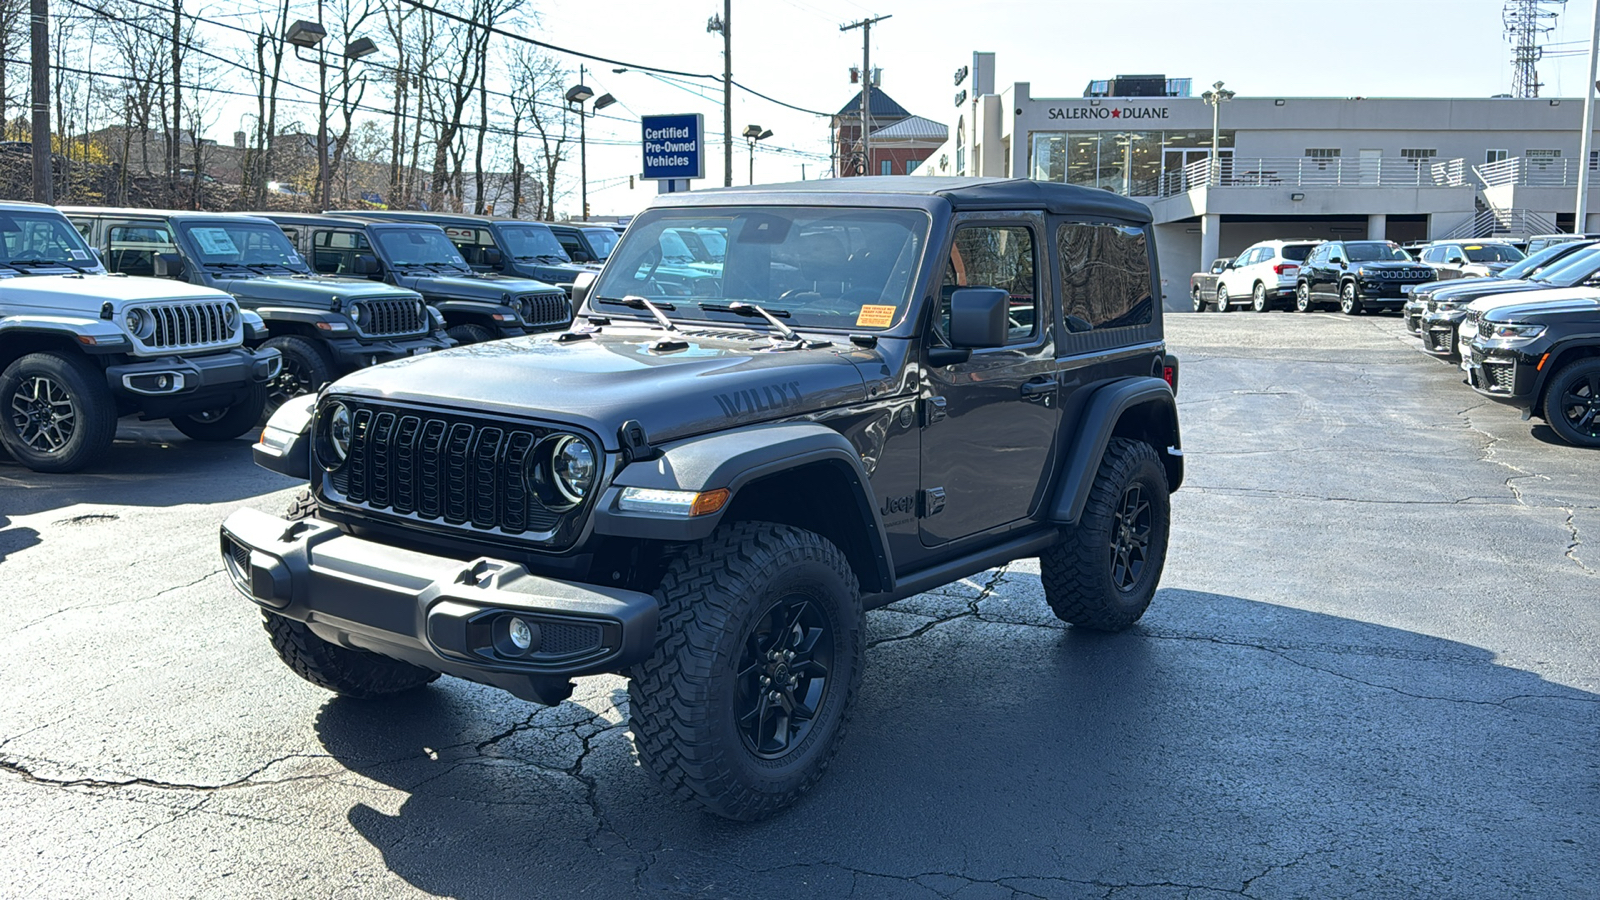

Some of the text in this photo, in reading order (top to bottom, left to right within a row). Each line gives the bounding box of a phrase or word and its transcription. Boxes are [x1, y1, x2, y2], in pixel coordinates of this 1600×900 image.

[1048, 107, 1169, 119] SALERNO DUANE
[645, 126, 689, 139] Certified
[645, 140, 696, 153] Pre-Owned
[646, 155, 689, 167] Vehicles
[713, 381, 804, 418] WILLYS
[880, 495, 914, 516] Jeep
